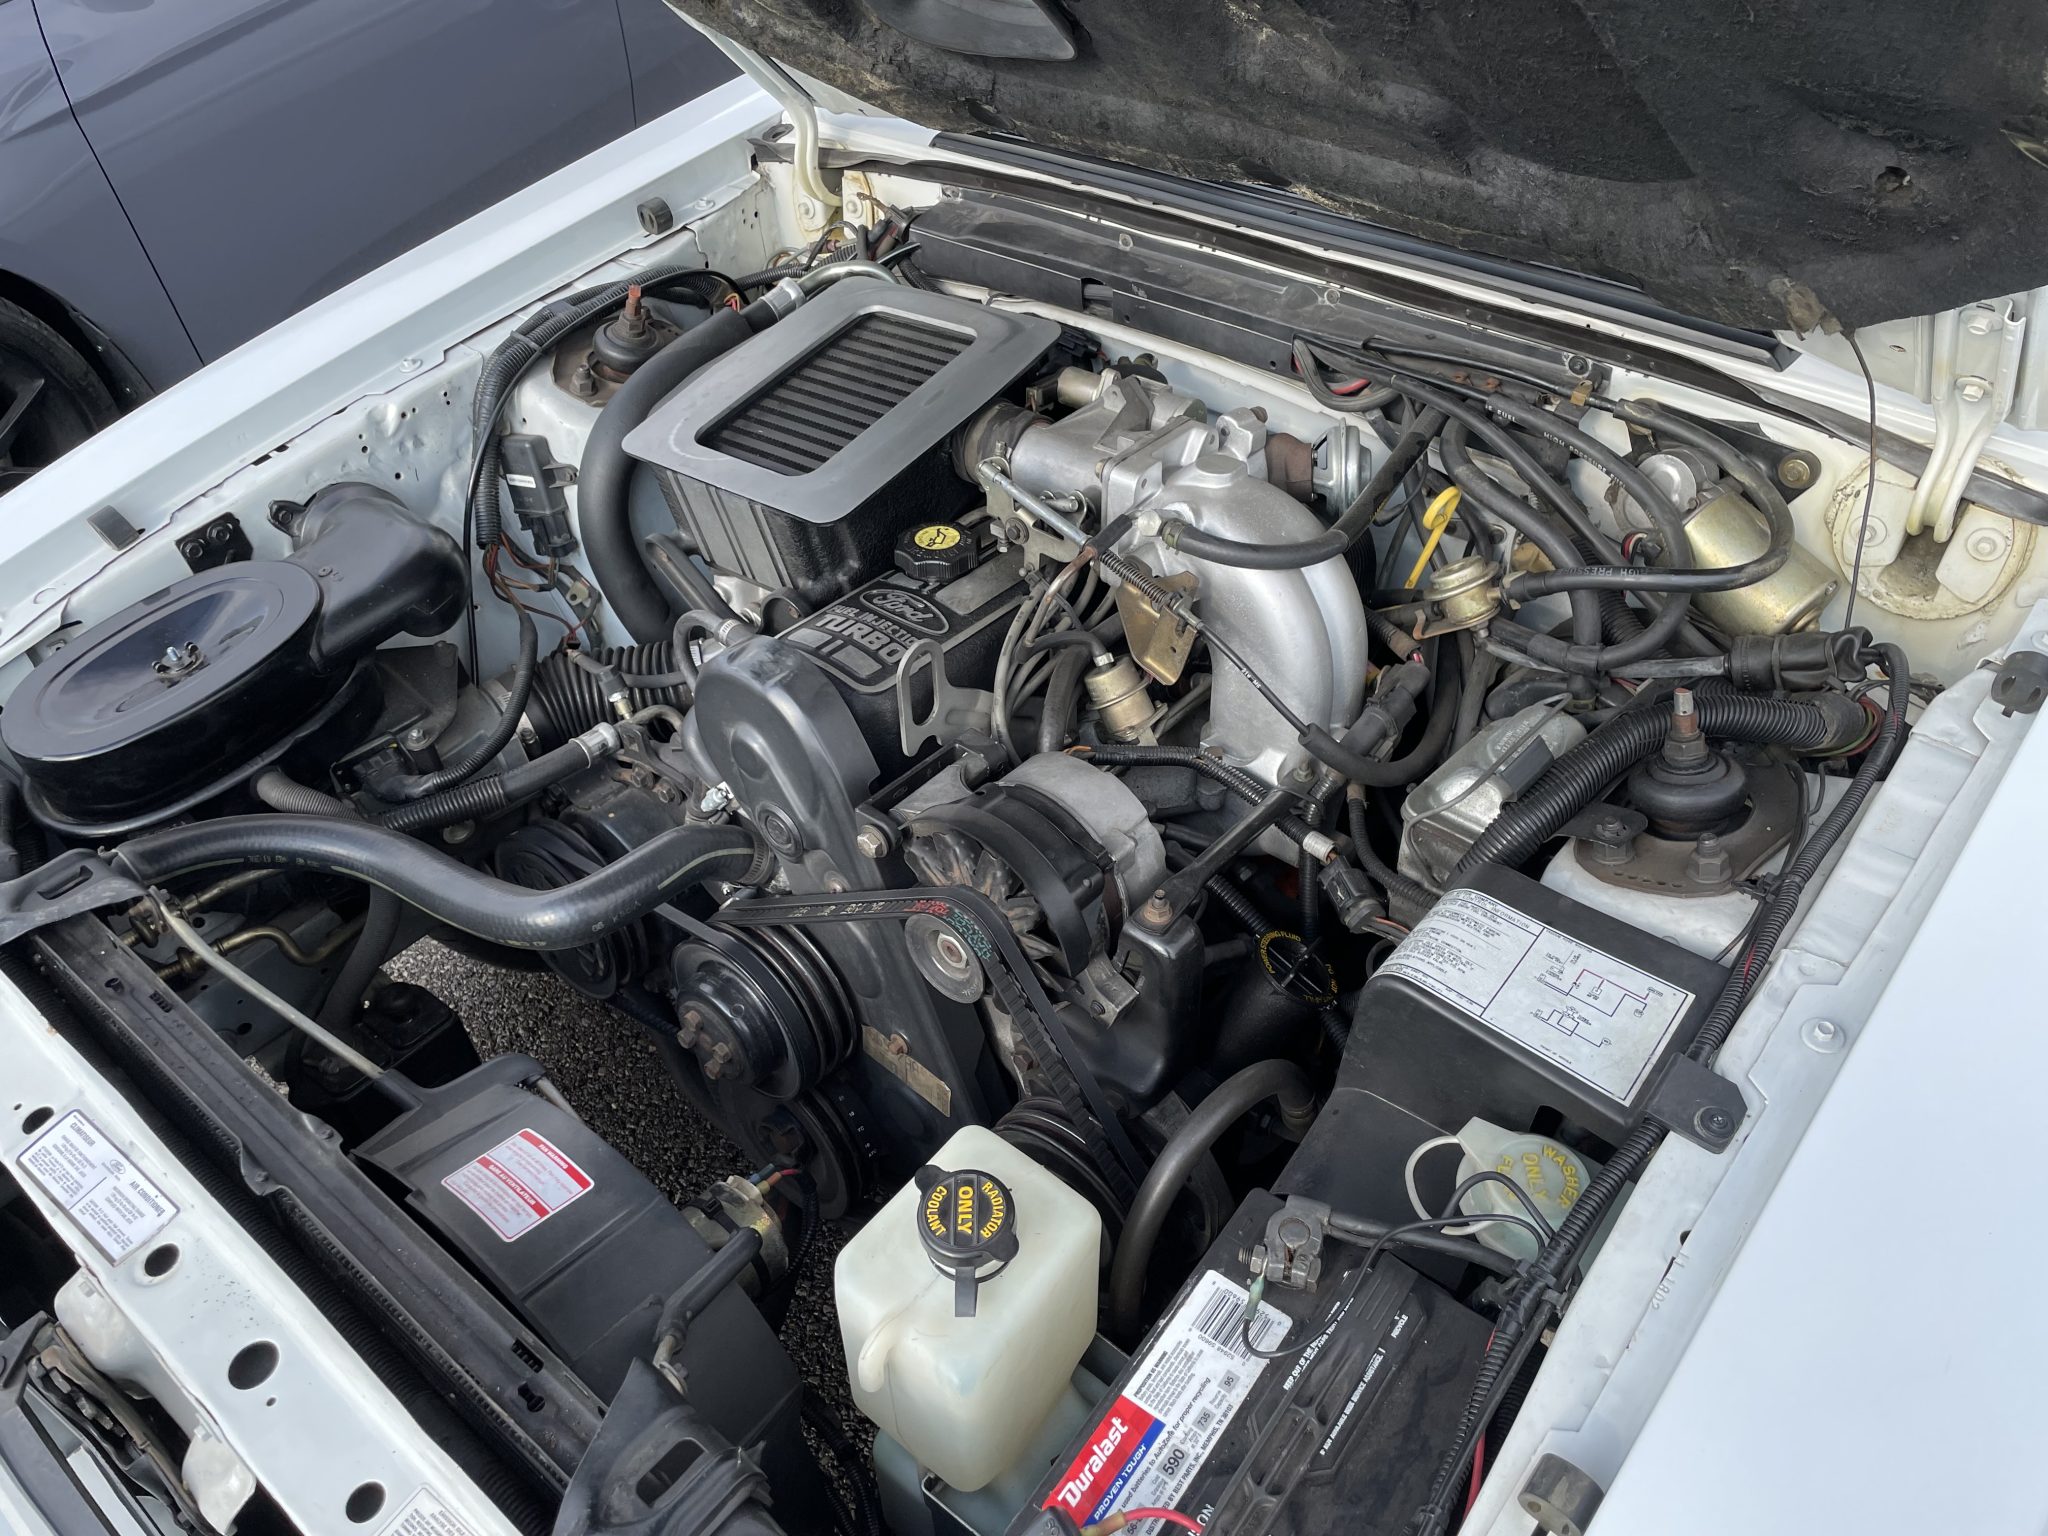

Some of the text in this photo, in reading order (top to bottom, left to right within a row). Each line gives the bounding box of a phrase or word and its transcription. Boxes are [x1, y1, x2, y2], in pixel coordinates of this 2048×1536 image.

[832, 604, 919, 649] FUEL INJECTIO
[873, 592, 934, 623] Ford
[816, 614, 906, 664] TURBO
[1490, 905, 1529, 929] INFORMATION
[128, 1179, 141, 1191] AIR
[136, 1186, 166, 1216] CONDITIONER
[1522, 1152, 1548, 1200] ONLY
[1542, 1144, 1581, 1209] WASHER
[926, 1185, 948, 1236] COOLANT
[958, 1186, 974, 1235] ONLY
[980, 1181, 1004, 1239] RADIATOR
[1389, 1313, 1410, 1338] RECYCLE
[1291, 1364, 1302, 1377] OUT
[1298, 1356, 1307, 1366] OF
[1302, 1346, 1313, 1358] THE
[1222, 1375, 1234, 1387] 95
[1196, 1410, 1211, 1427] 735
[1056, 1413, 1130, 1510] Duralast
[1119, 1491, 1134, 1508] used
[1129, 1465, 1151, 1493] batteries
[1147, 1457, 1156, 1466] to
[1171, 1419, 1181, 1431] for
[1178, 1401, 1195, 1422] proper
[1190, 1376, 1212, 1403] recycling
[1160, 1446, 1186, 1476] 590
[1166, 1491, 1176, 1502] BY
[1171, 1478, 1185, 1494] BEST
[1180, 1460, 1197, 1481] PARTS,
[1199, 1424, 1220, 1450] MEMPHIS,
[1215, 1417, 1224, 1426] TN
[1092, 1443, 1147, 1520] PROVEN TOUGH
